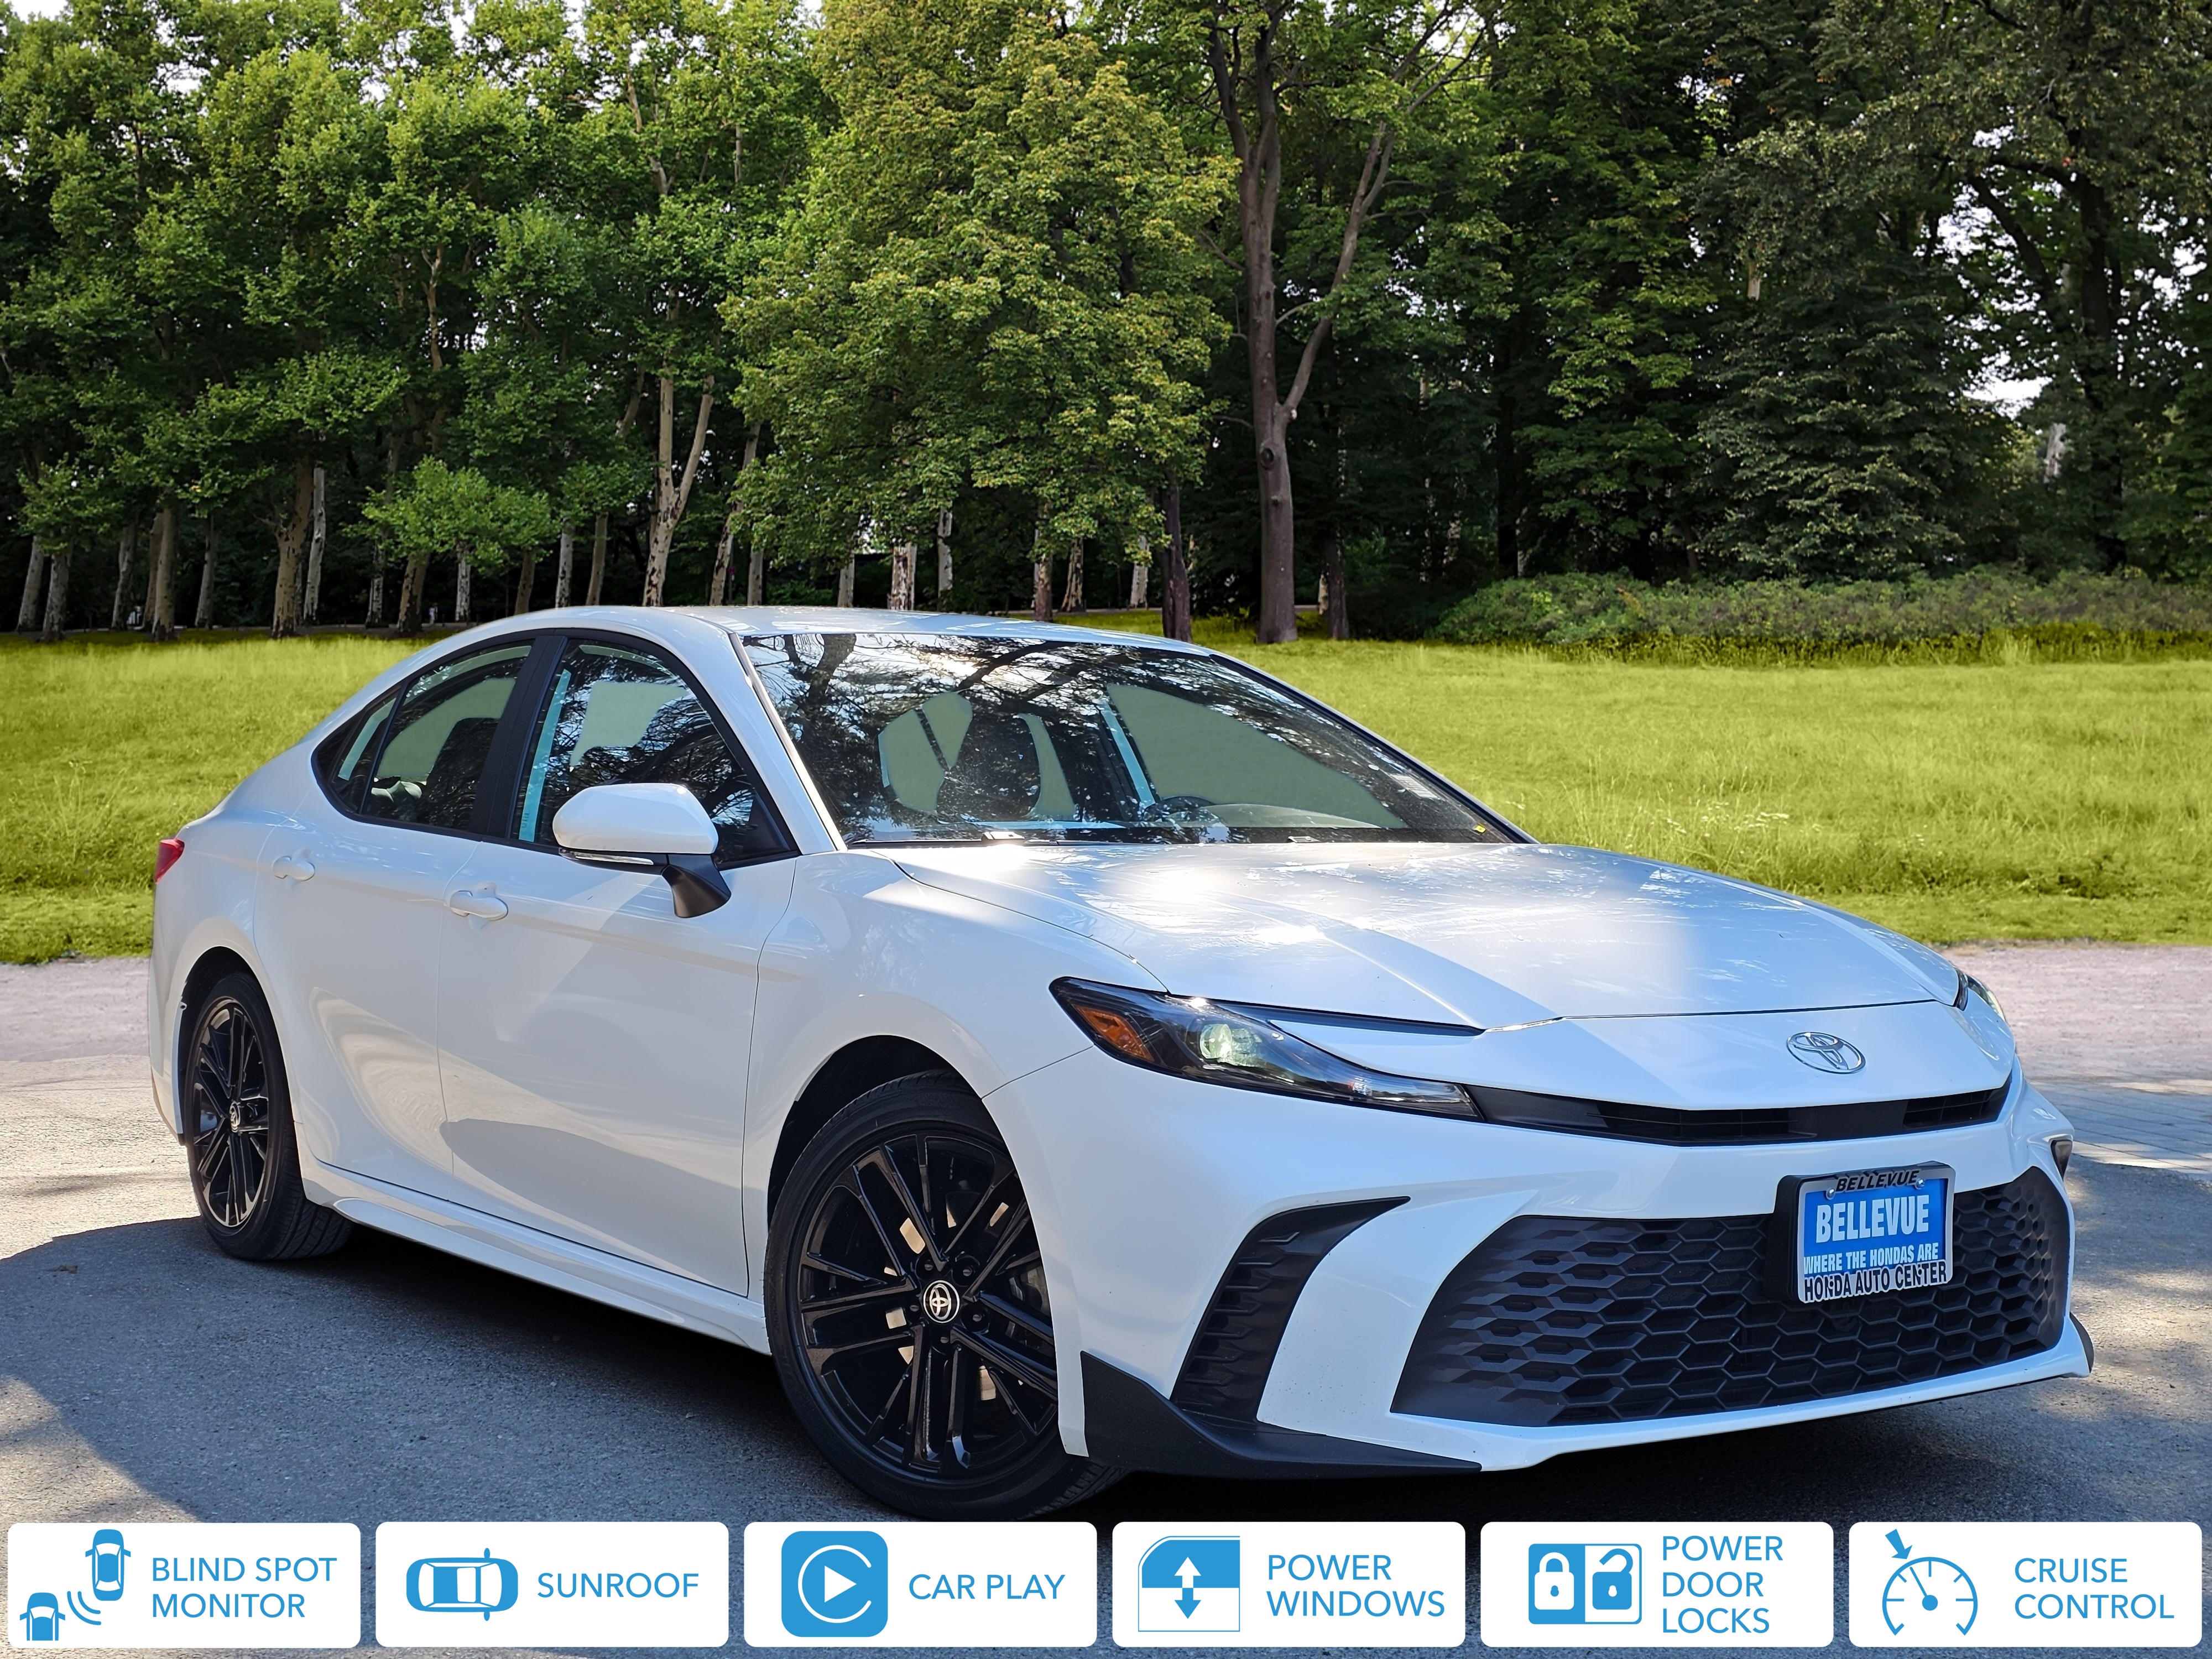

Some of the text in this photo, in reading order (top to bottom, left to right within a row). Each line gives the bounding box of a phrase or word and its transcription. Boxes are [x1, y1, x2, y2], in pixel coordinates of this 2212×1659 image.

[1835, 1170, 1919, 1192] BELLEVUE
[1816, 1194, 1929, 1243] BELLEVUE
[1804, 1243, 1939, 1274] WHERE THE HONDAS ARE
[1804, 1261, 1947, 1301] HONDA AUTO CENTER
